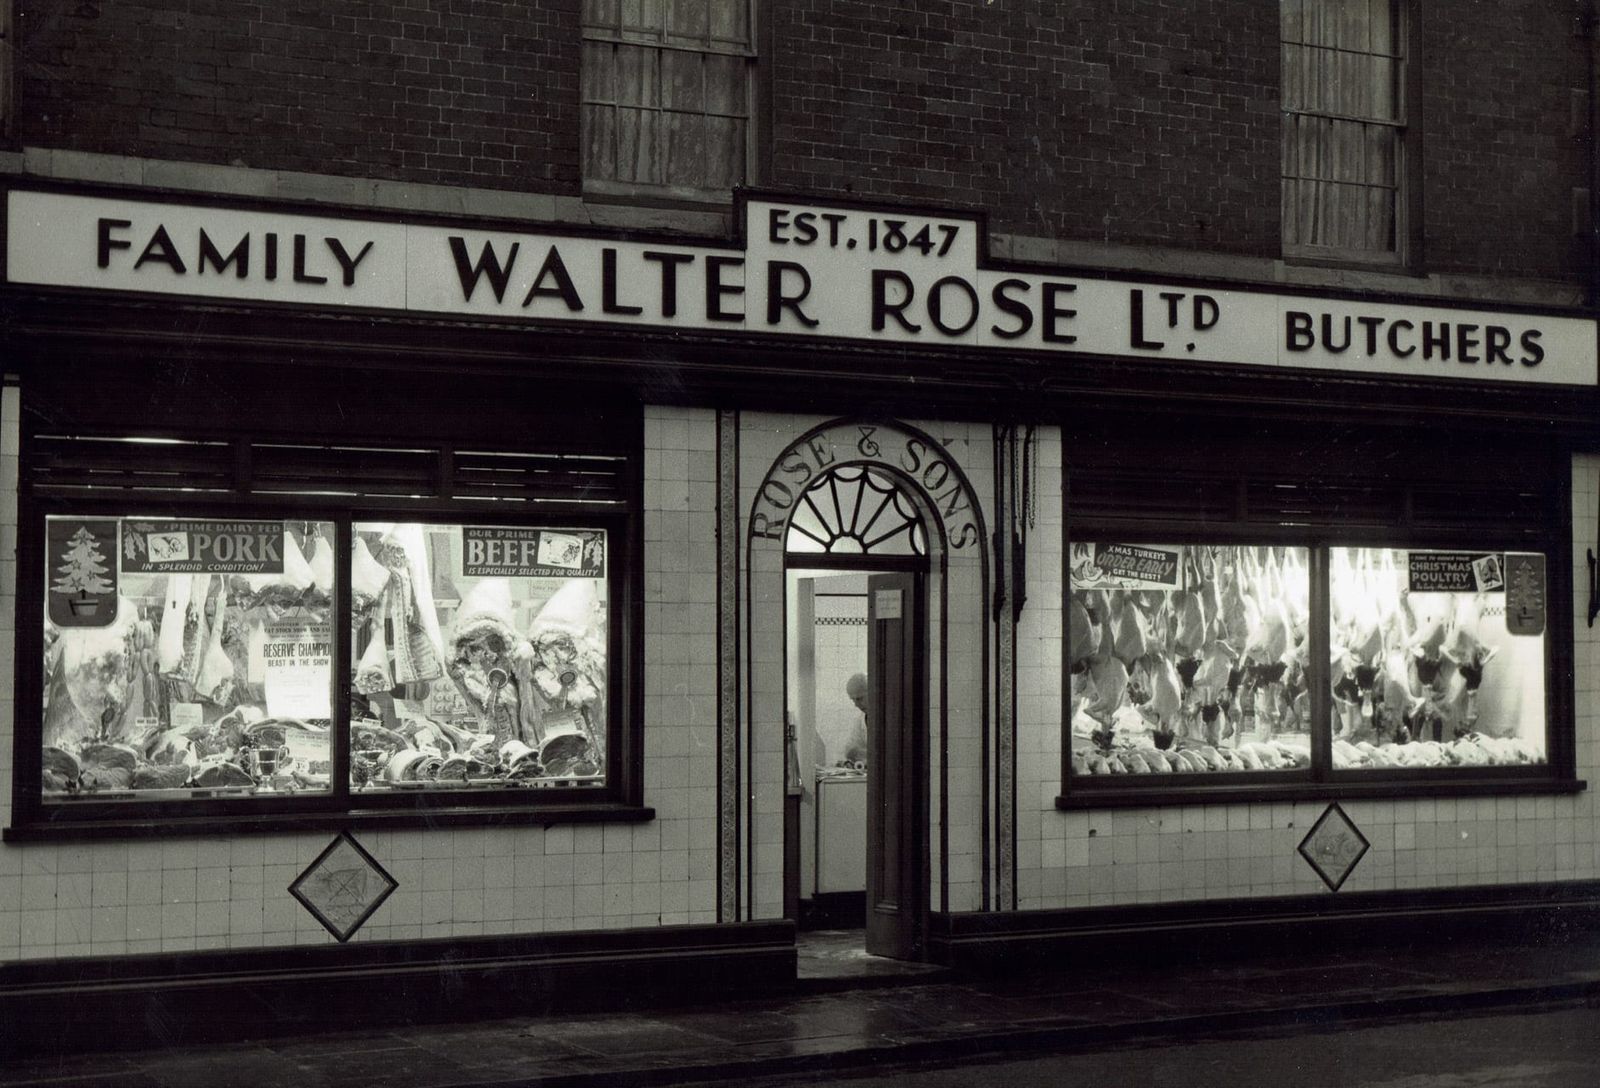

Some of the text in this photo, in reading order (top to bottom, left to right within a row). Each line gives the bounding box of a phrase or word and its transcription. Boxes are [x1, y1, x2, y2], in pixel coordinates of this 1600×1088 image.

[769, 208, 960, 258] EST. 1847
[97, 217, 374, 287] FAMILY
[448, 236, 820, 330] WALTER
[871, 269, 1078, 345] ROSE
[1285, 310, 1545, 368] BUTCHERS
[753, 426, 978, 549] ROSE & SONS
[170, 523, 281, 533] PRIME DAIRY FED
[469, 530, 534, 539] OUR PRIME
[192, 533, 281, 562] PORK
[467, 539, 536, 567] BEEF
[1107, 545, 1167, 561] XMAS TURKEYS
[141, 563, 265, 571] IN SPLENDID CONDITION!
[468, 567, 598, 577] IS ESPECIALLY SELECTED FOR QUALITY
[1096, 552, 1175, 576] ORDER EARLY
[1410, 562, 1472, 572] CHRISTMAS
[1113, 568, 1126, 576] GET
[1127, 570, 1138, 578] THE
[1412, 572, 1469, 583] POULTRY
[263, 642, 331, 658] RESERVE CHAMPIO
